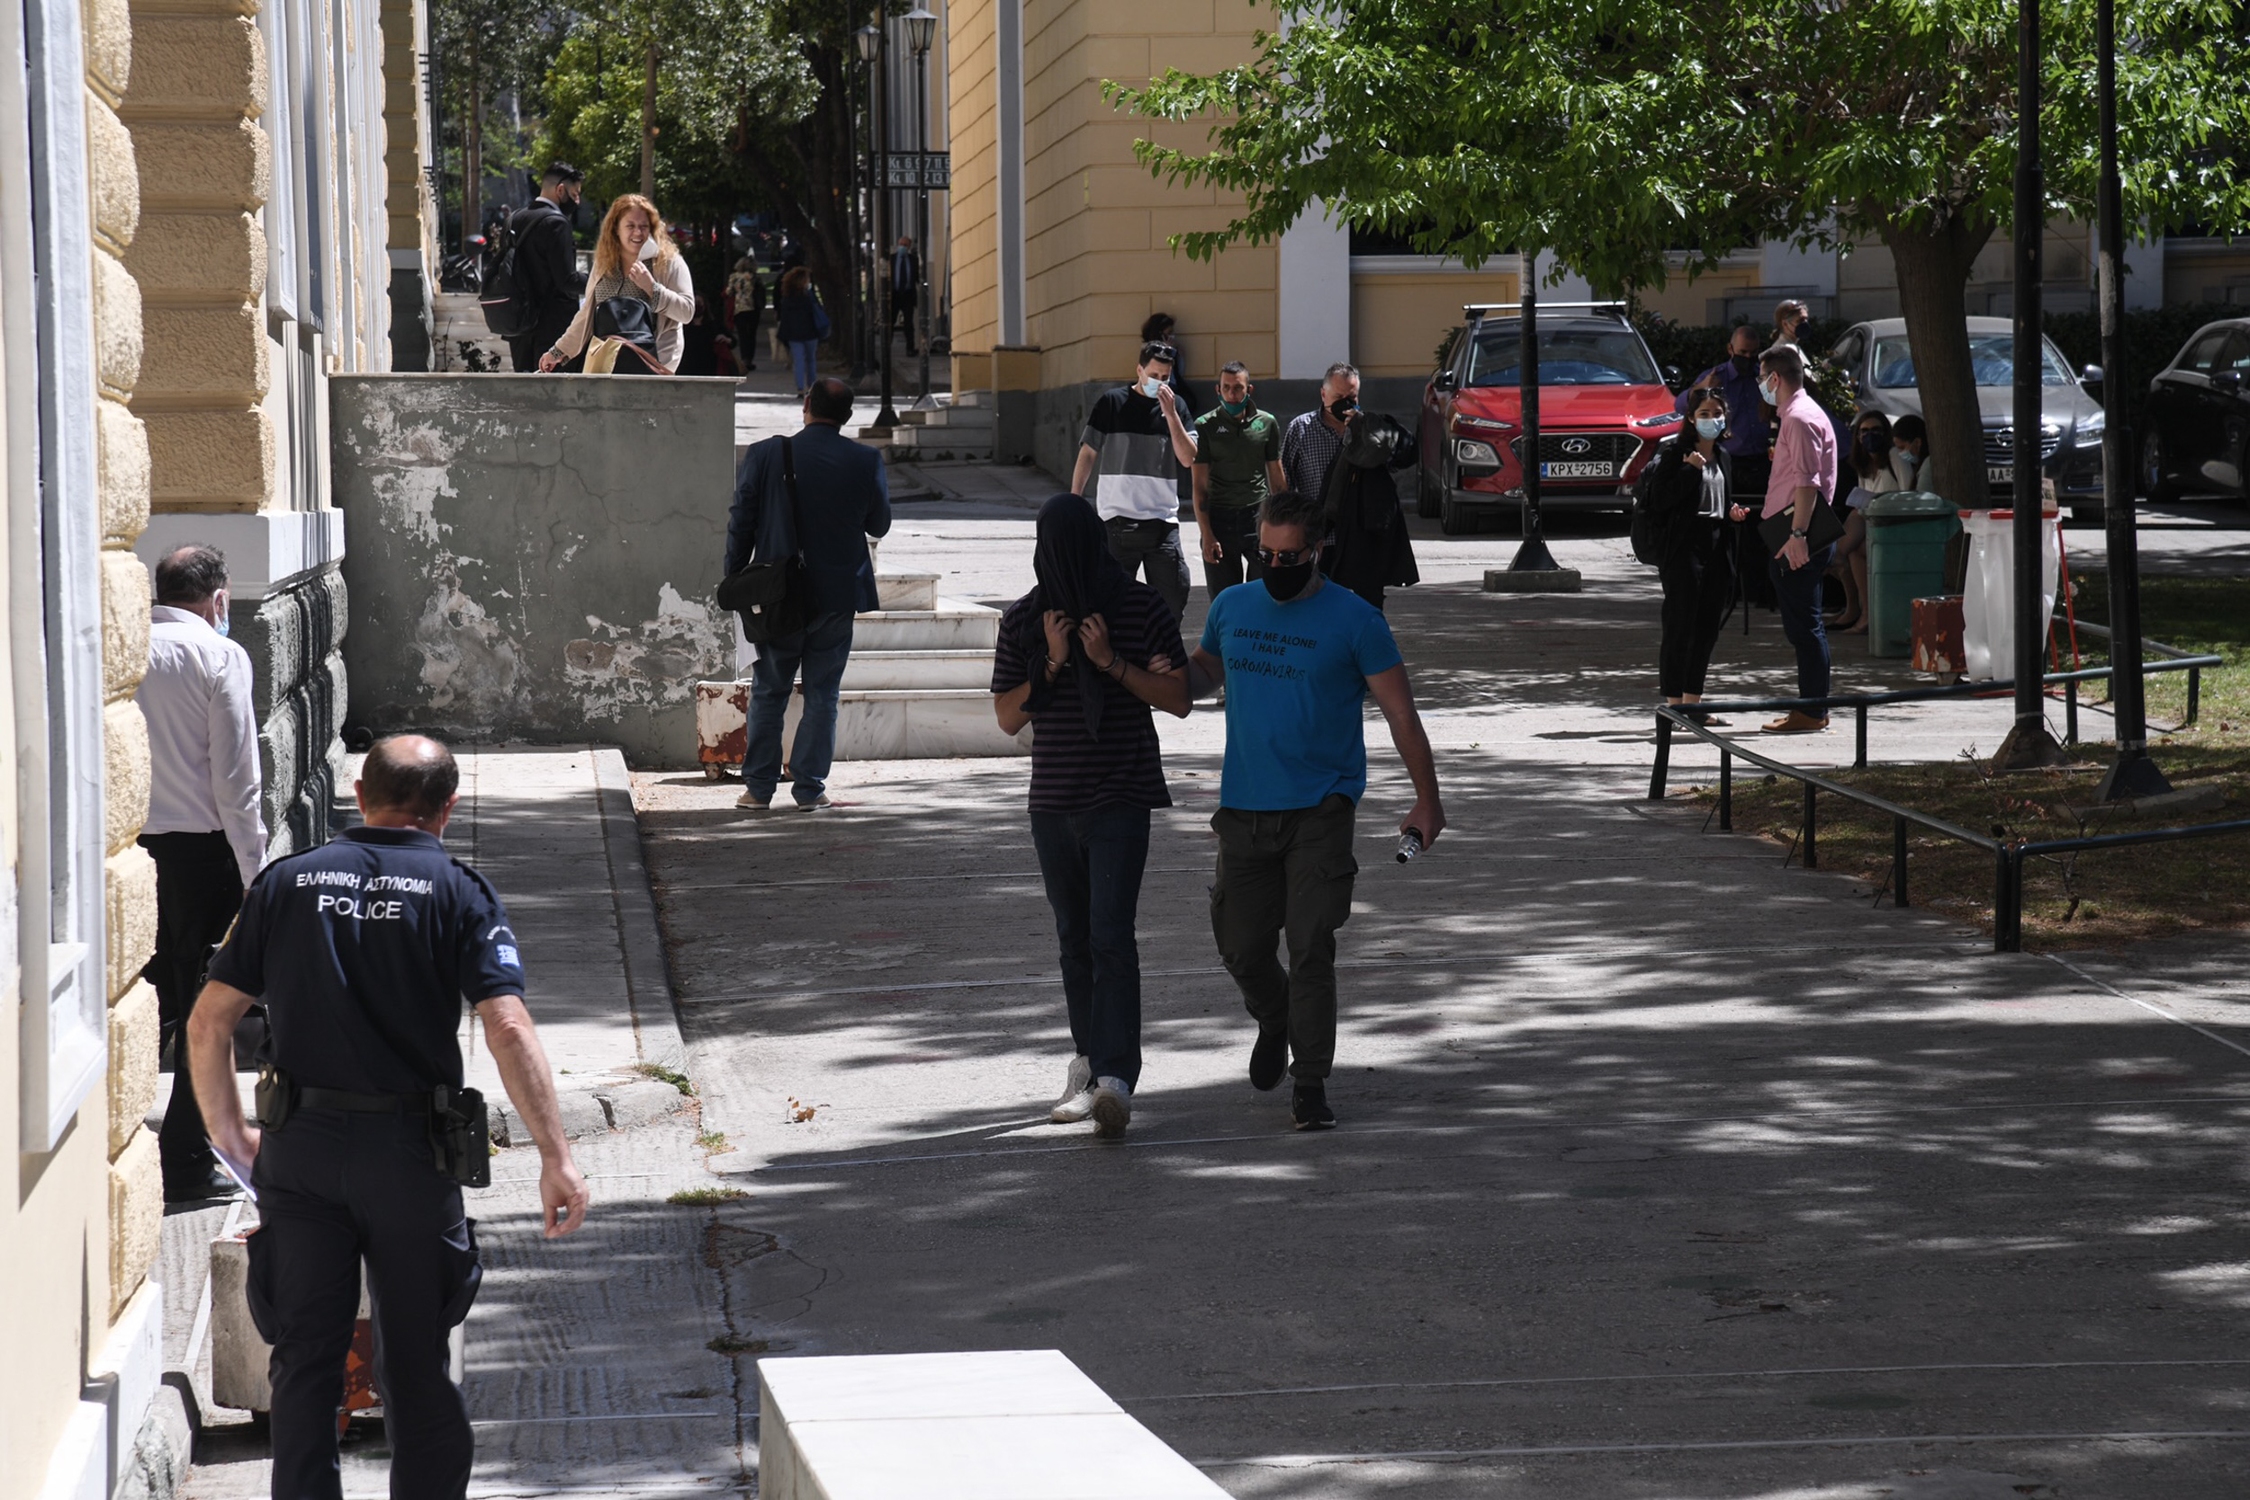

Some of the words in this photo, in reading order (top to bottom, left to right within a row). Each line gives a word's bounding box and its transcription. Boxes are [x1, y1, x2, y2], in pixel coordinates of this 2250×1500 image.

[1233, 628, 1262, 640] LEAVE
[1262, 631, 1279, 643] ME
[1279, 634, 1318, 650] ALONE!
[1252, 641, 1257, 651] I
[1258, 642, 1287, 656] HAVE
[1227, 657, 1306, 681] CORONAVIRUS
[296, 871, 361, 889] ΕΛΛΗΝΙΚΗ
[363, 876, 433, 894] ΑΣΤΥΝΟΜΙΑ
[317, 894, 403, 920] POLICE
